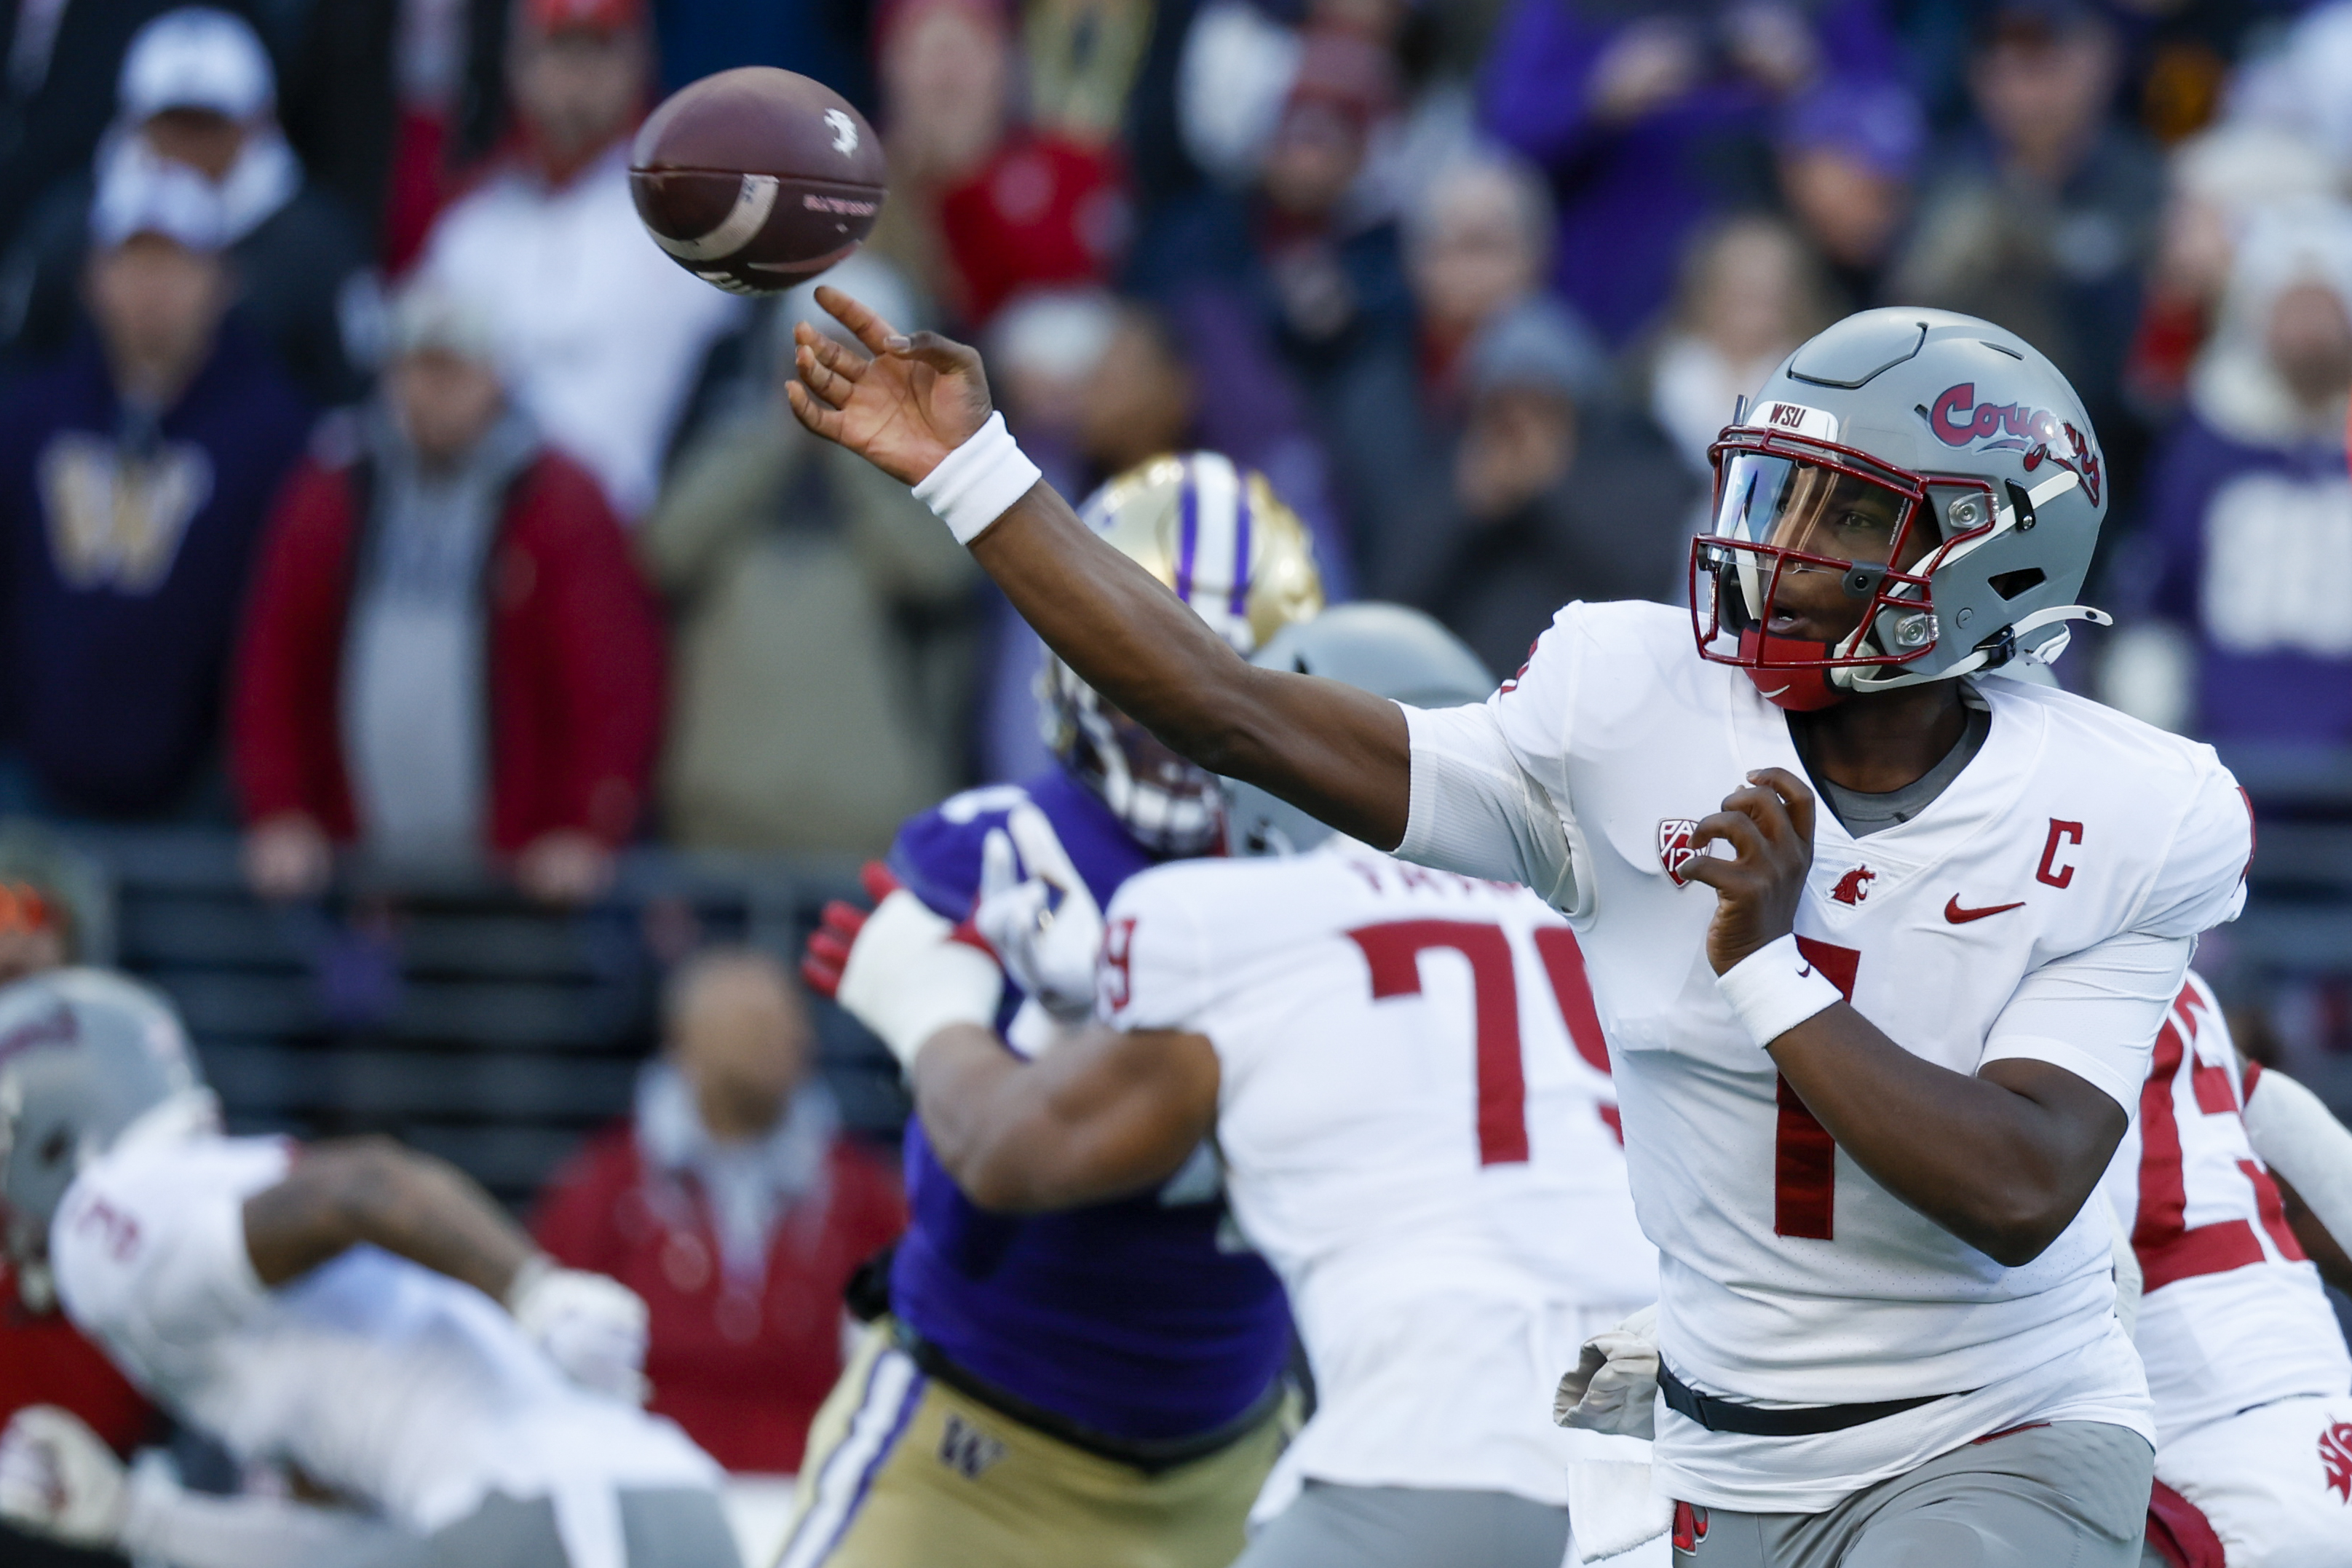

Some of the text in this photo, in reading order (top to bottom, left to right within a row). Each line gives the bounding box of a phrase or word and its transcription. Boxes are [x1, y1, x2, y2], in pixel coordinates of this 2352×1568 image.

[1769, 403, 1807, 429] WSU
[2036, 817, 2083, 889] C
[938, 1414, 1003, 1479] W
